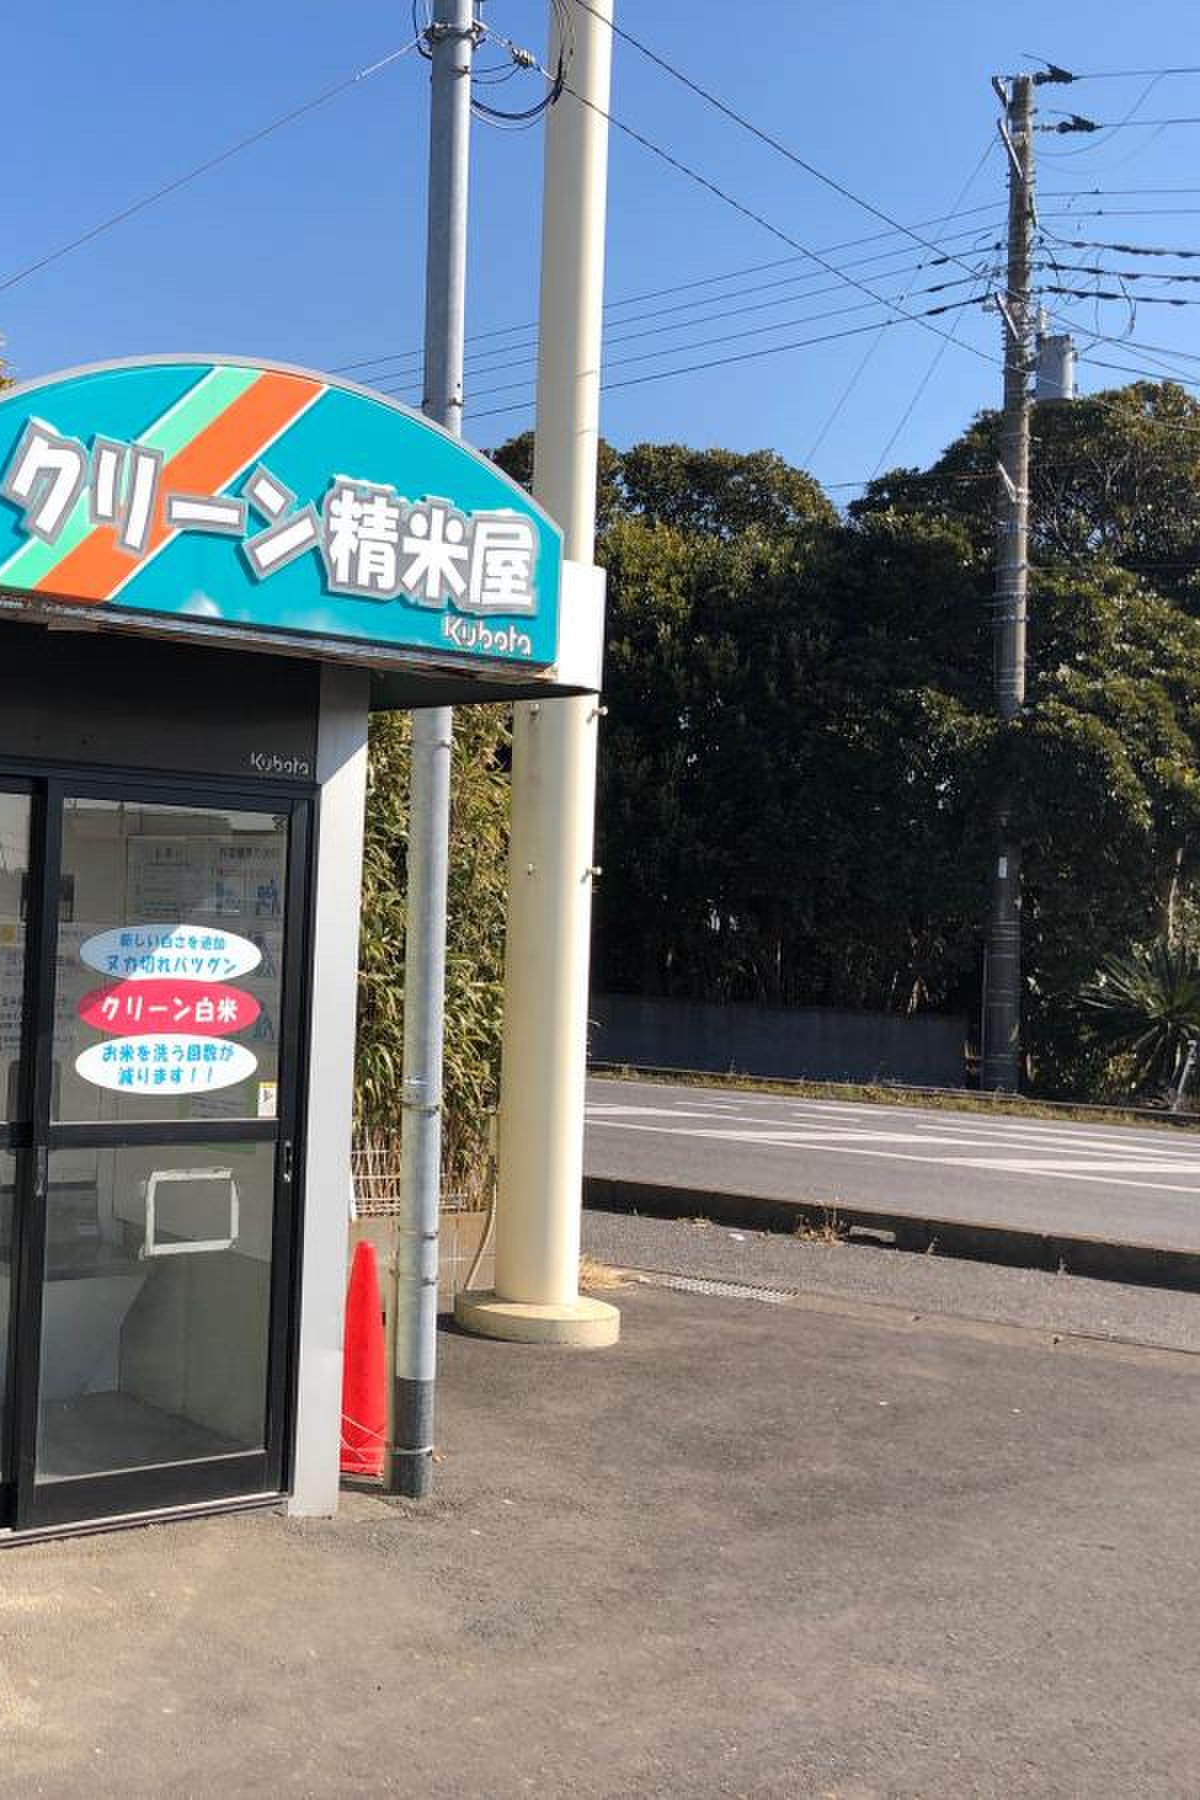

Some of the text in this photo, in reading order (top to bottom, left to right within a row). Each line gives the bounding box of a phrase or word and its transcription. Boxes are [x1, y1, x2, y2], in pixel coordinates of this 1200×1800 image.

[3, 418, 537, 614] クリーン精米屋
[444, 614, 531, 656] Kubota
[250, 751, 309, 775] Kubota
[105, 954, 238, 975] ヌカ切れバツグン
[101, 996, 239, 1023] クリーン白米
[101, 1043, 235, 1063] お米を洗う回数が
